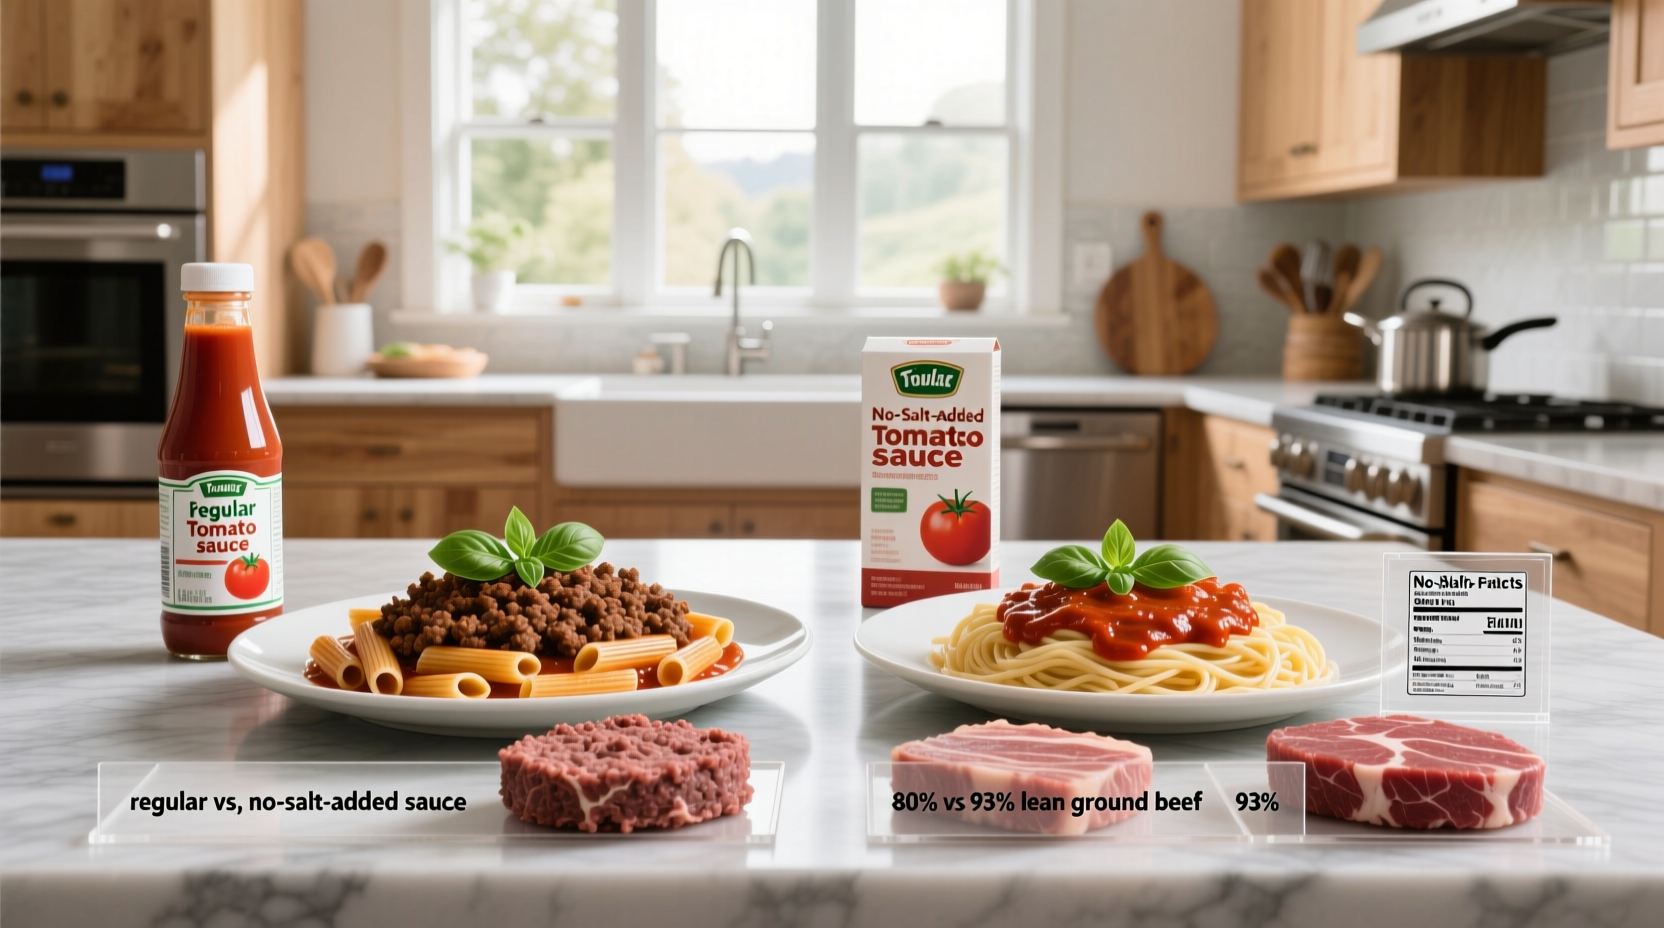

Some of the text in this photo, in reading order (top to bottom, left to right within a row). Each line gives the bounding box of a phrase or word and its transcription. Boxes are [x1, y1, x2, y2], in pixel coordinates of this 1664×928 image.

[872, 406, 984, 423] No-Salt-Added
[872, 447, 963, 467] sauce
[186, 519, 257, 537] Tomato
[196, 539, 249, 554] sauce
[130, 790, 467, 817] regular vs, no-salt-added sauce
[891, 790, 1203, 817] 80% vs 93% lean ground beef
[1235, 791, 1280, 812] 93%
